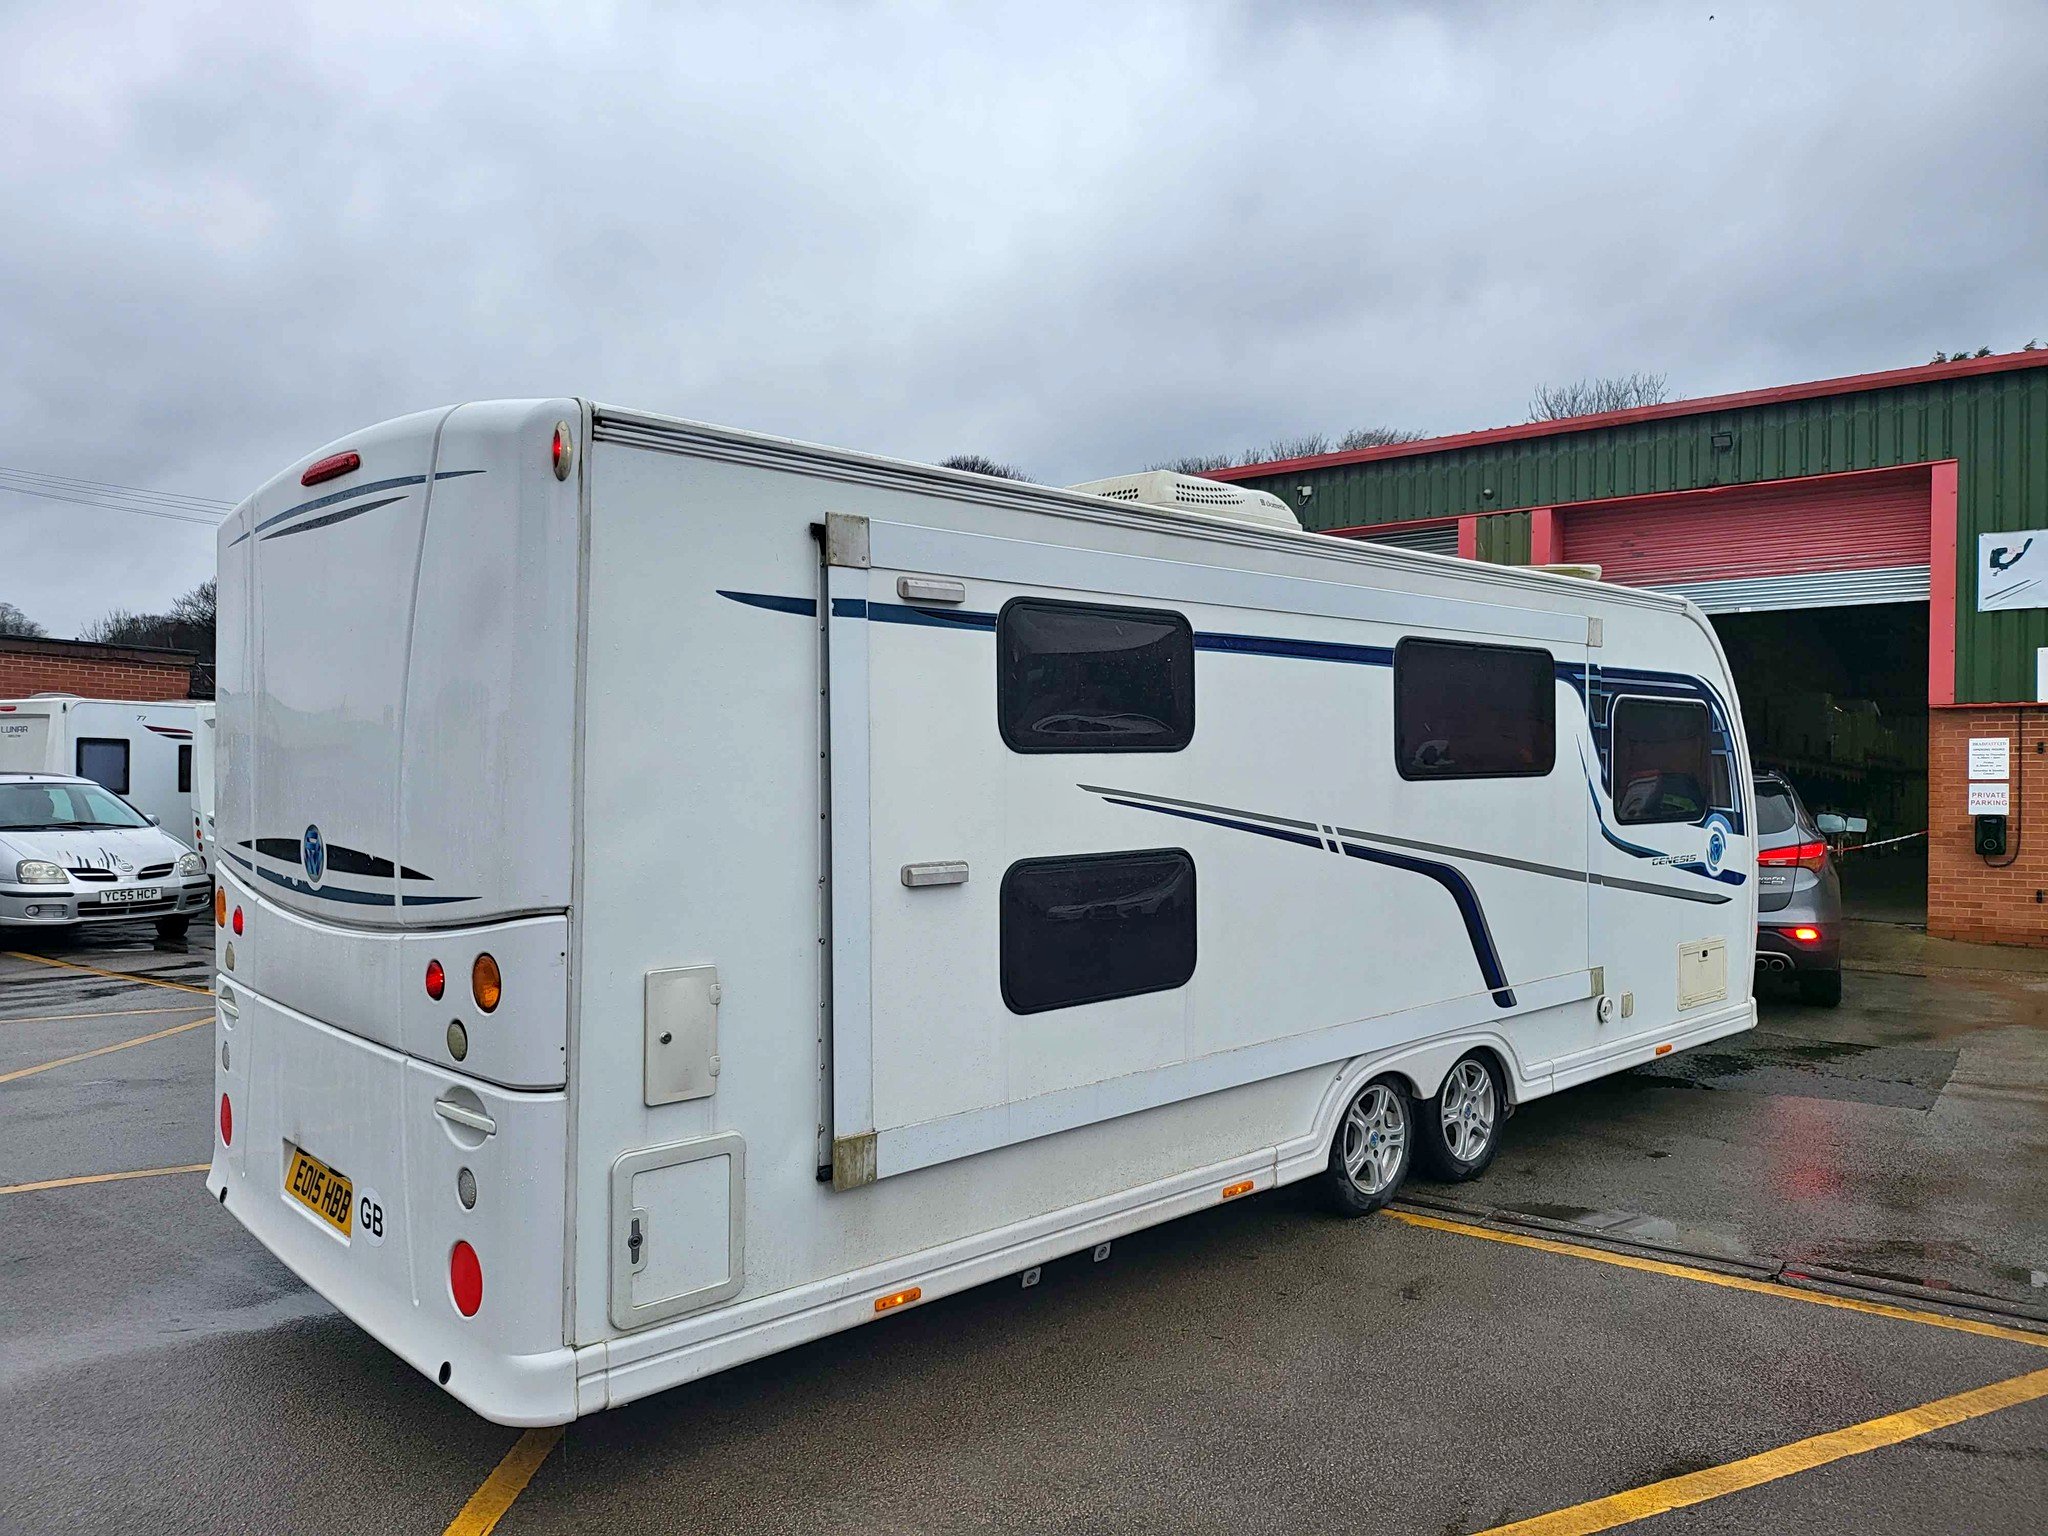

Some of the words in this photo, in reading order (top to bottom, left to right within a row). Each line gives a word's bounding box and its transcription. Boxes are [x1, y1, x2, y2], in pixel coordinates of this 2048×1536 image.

[1, 725, 29, 733] LUNAR
[1652, 854, 1697, 866] GENESIS
[104, 890, 134, 902] YC55
[136, 888, 158, 900] HCP
[320, 1178, 352, 1224] HBB
[360, 1196, 383, 1237] GB
